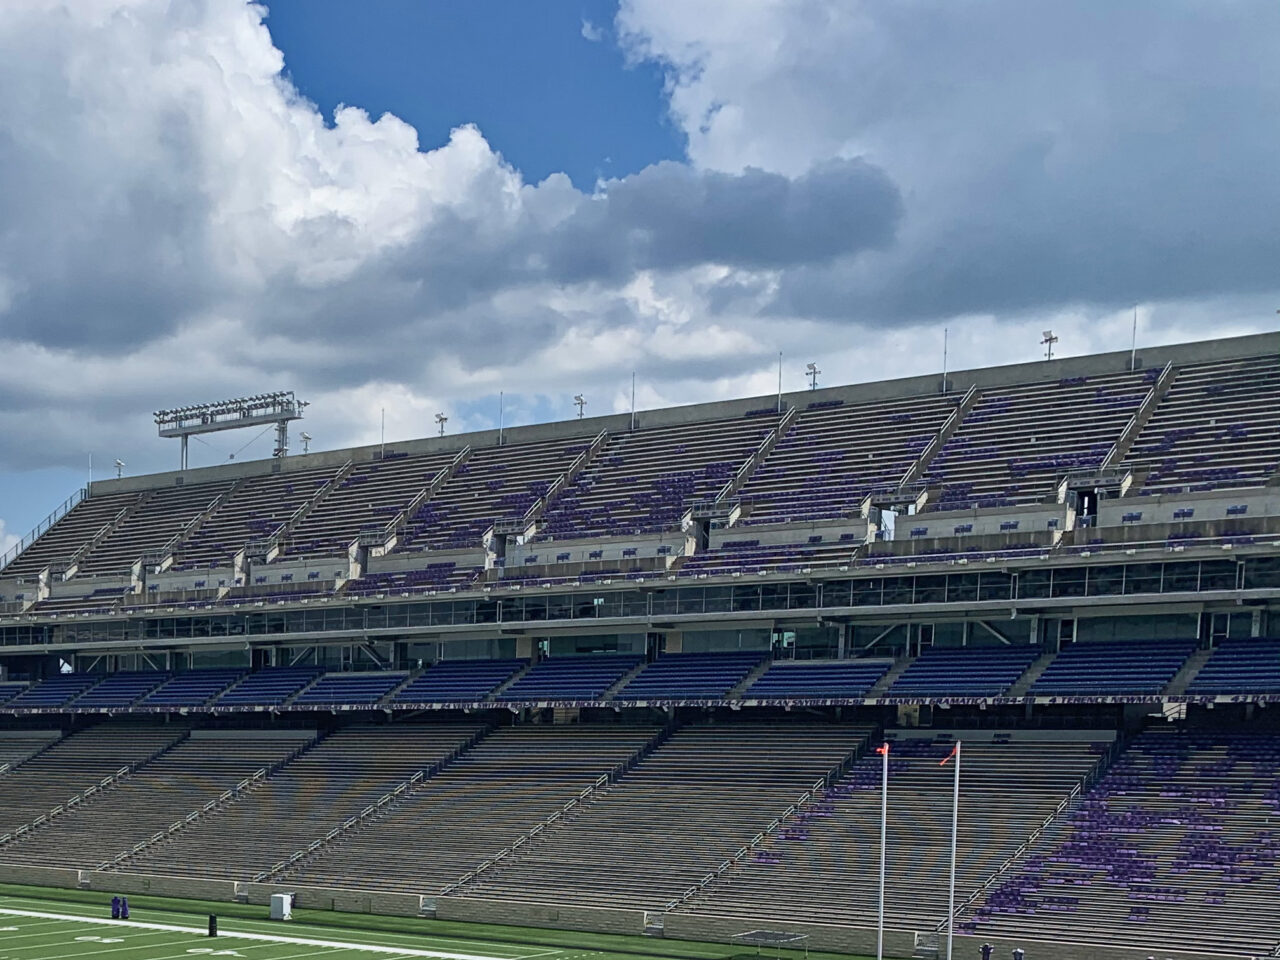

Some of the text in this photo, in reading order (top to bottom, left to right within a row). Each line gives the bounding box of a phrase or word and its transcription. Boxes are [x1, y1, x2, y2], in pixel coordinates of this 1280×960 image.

[575, 701, 602, 709] DICKEY
[791, 699, 826, 707] SNYDER
[888, 698, 925, 706] MARTIN
